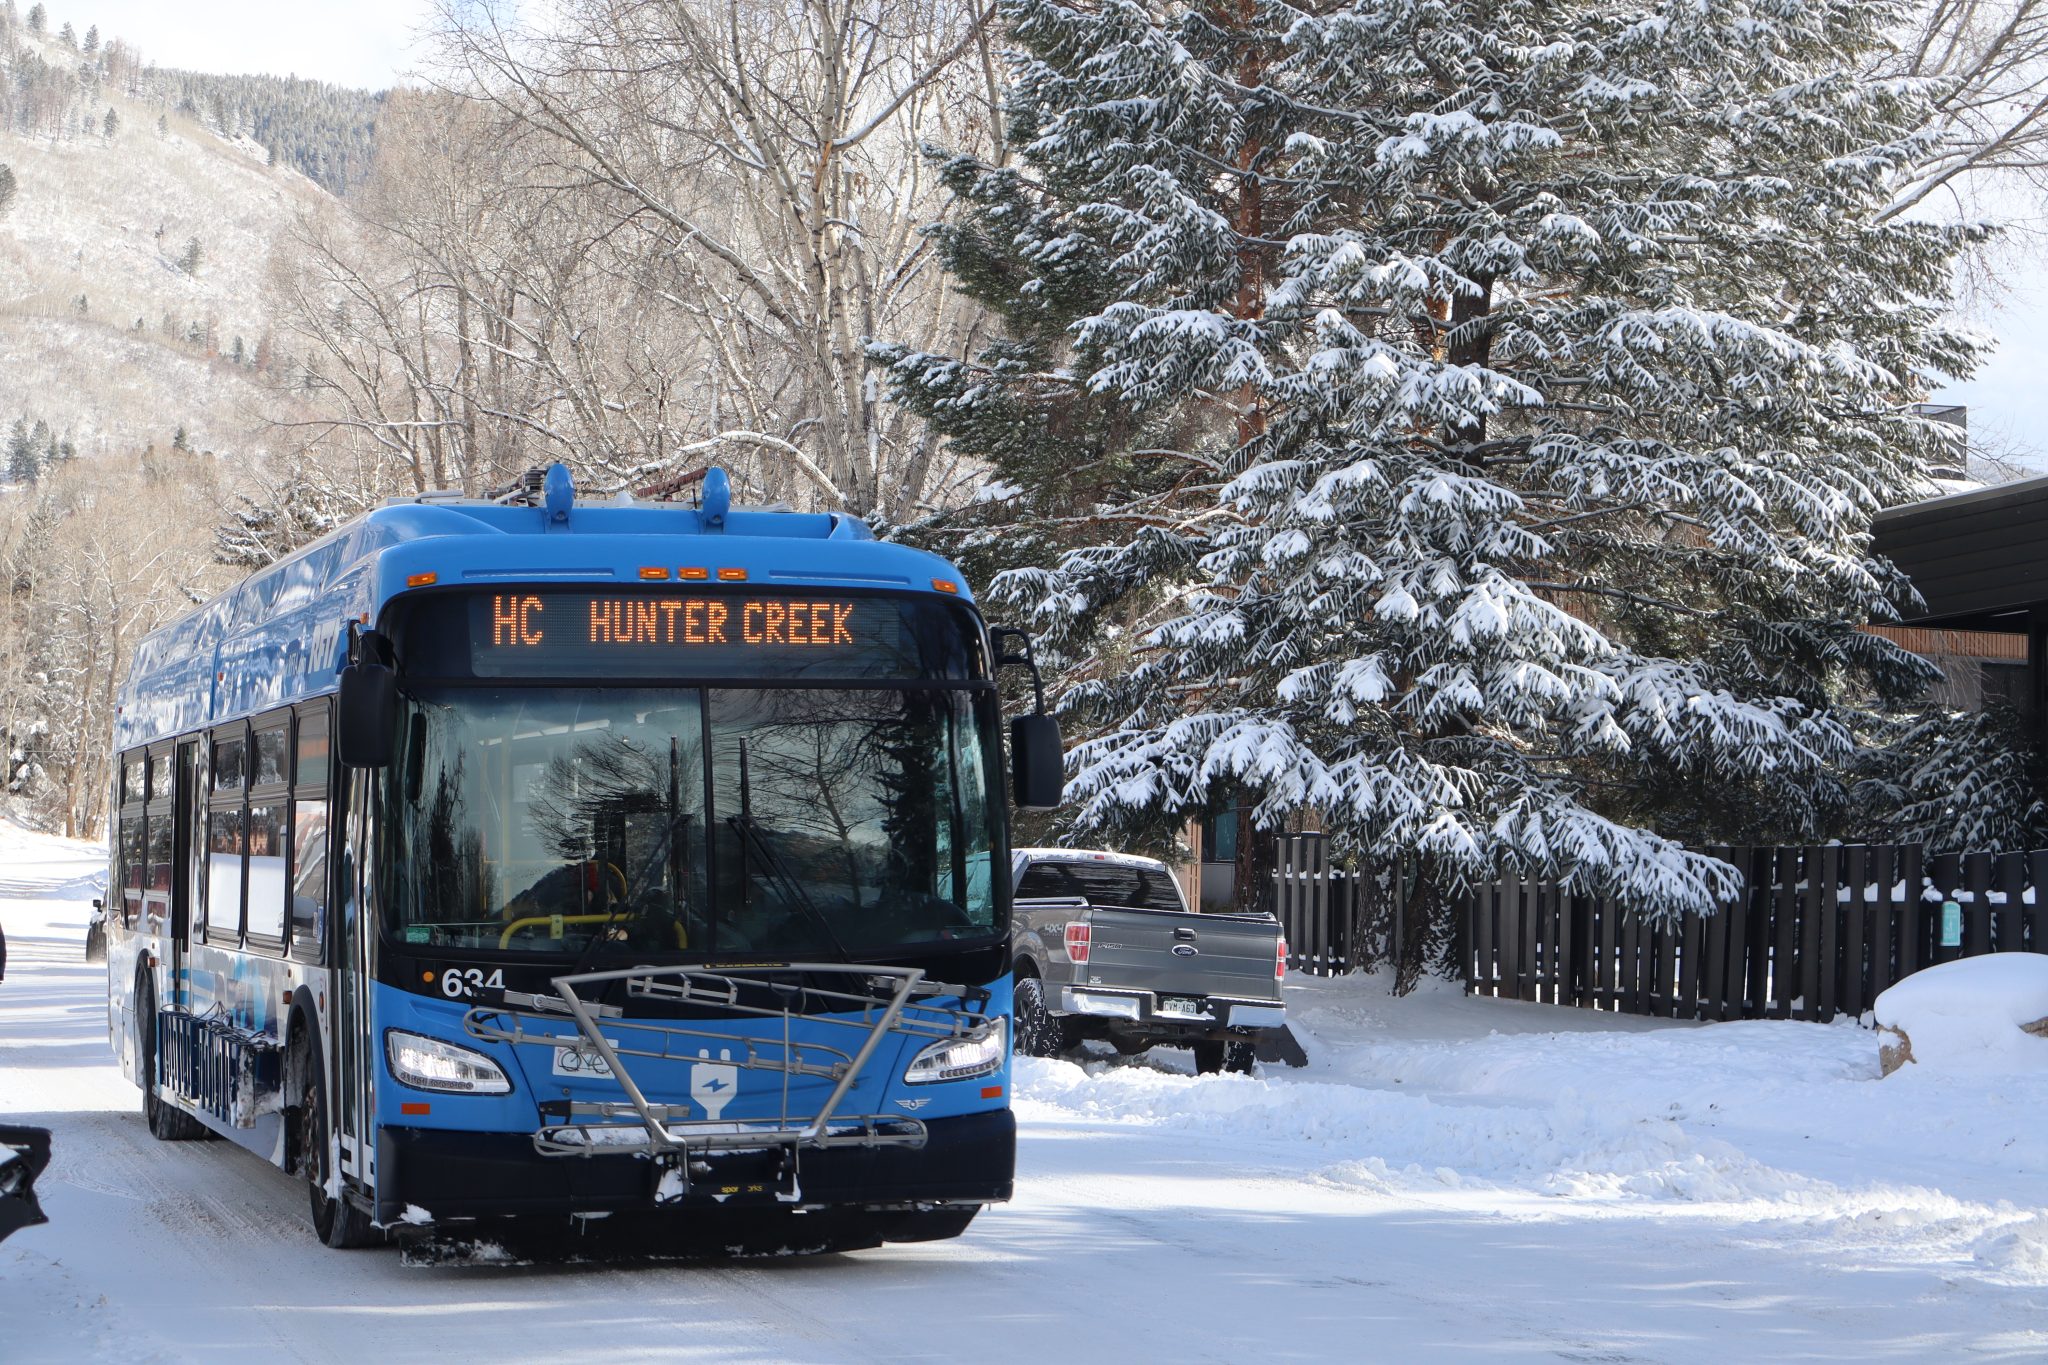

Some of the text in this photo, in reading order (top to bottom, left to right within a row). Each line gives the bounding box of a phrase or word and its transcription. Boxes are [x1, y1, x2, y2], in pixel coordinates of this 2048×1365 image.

[492, 595, 853, 645] HC HUNTER CREEK
[442, 968, 506, 997] 634
